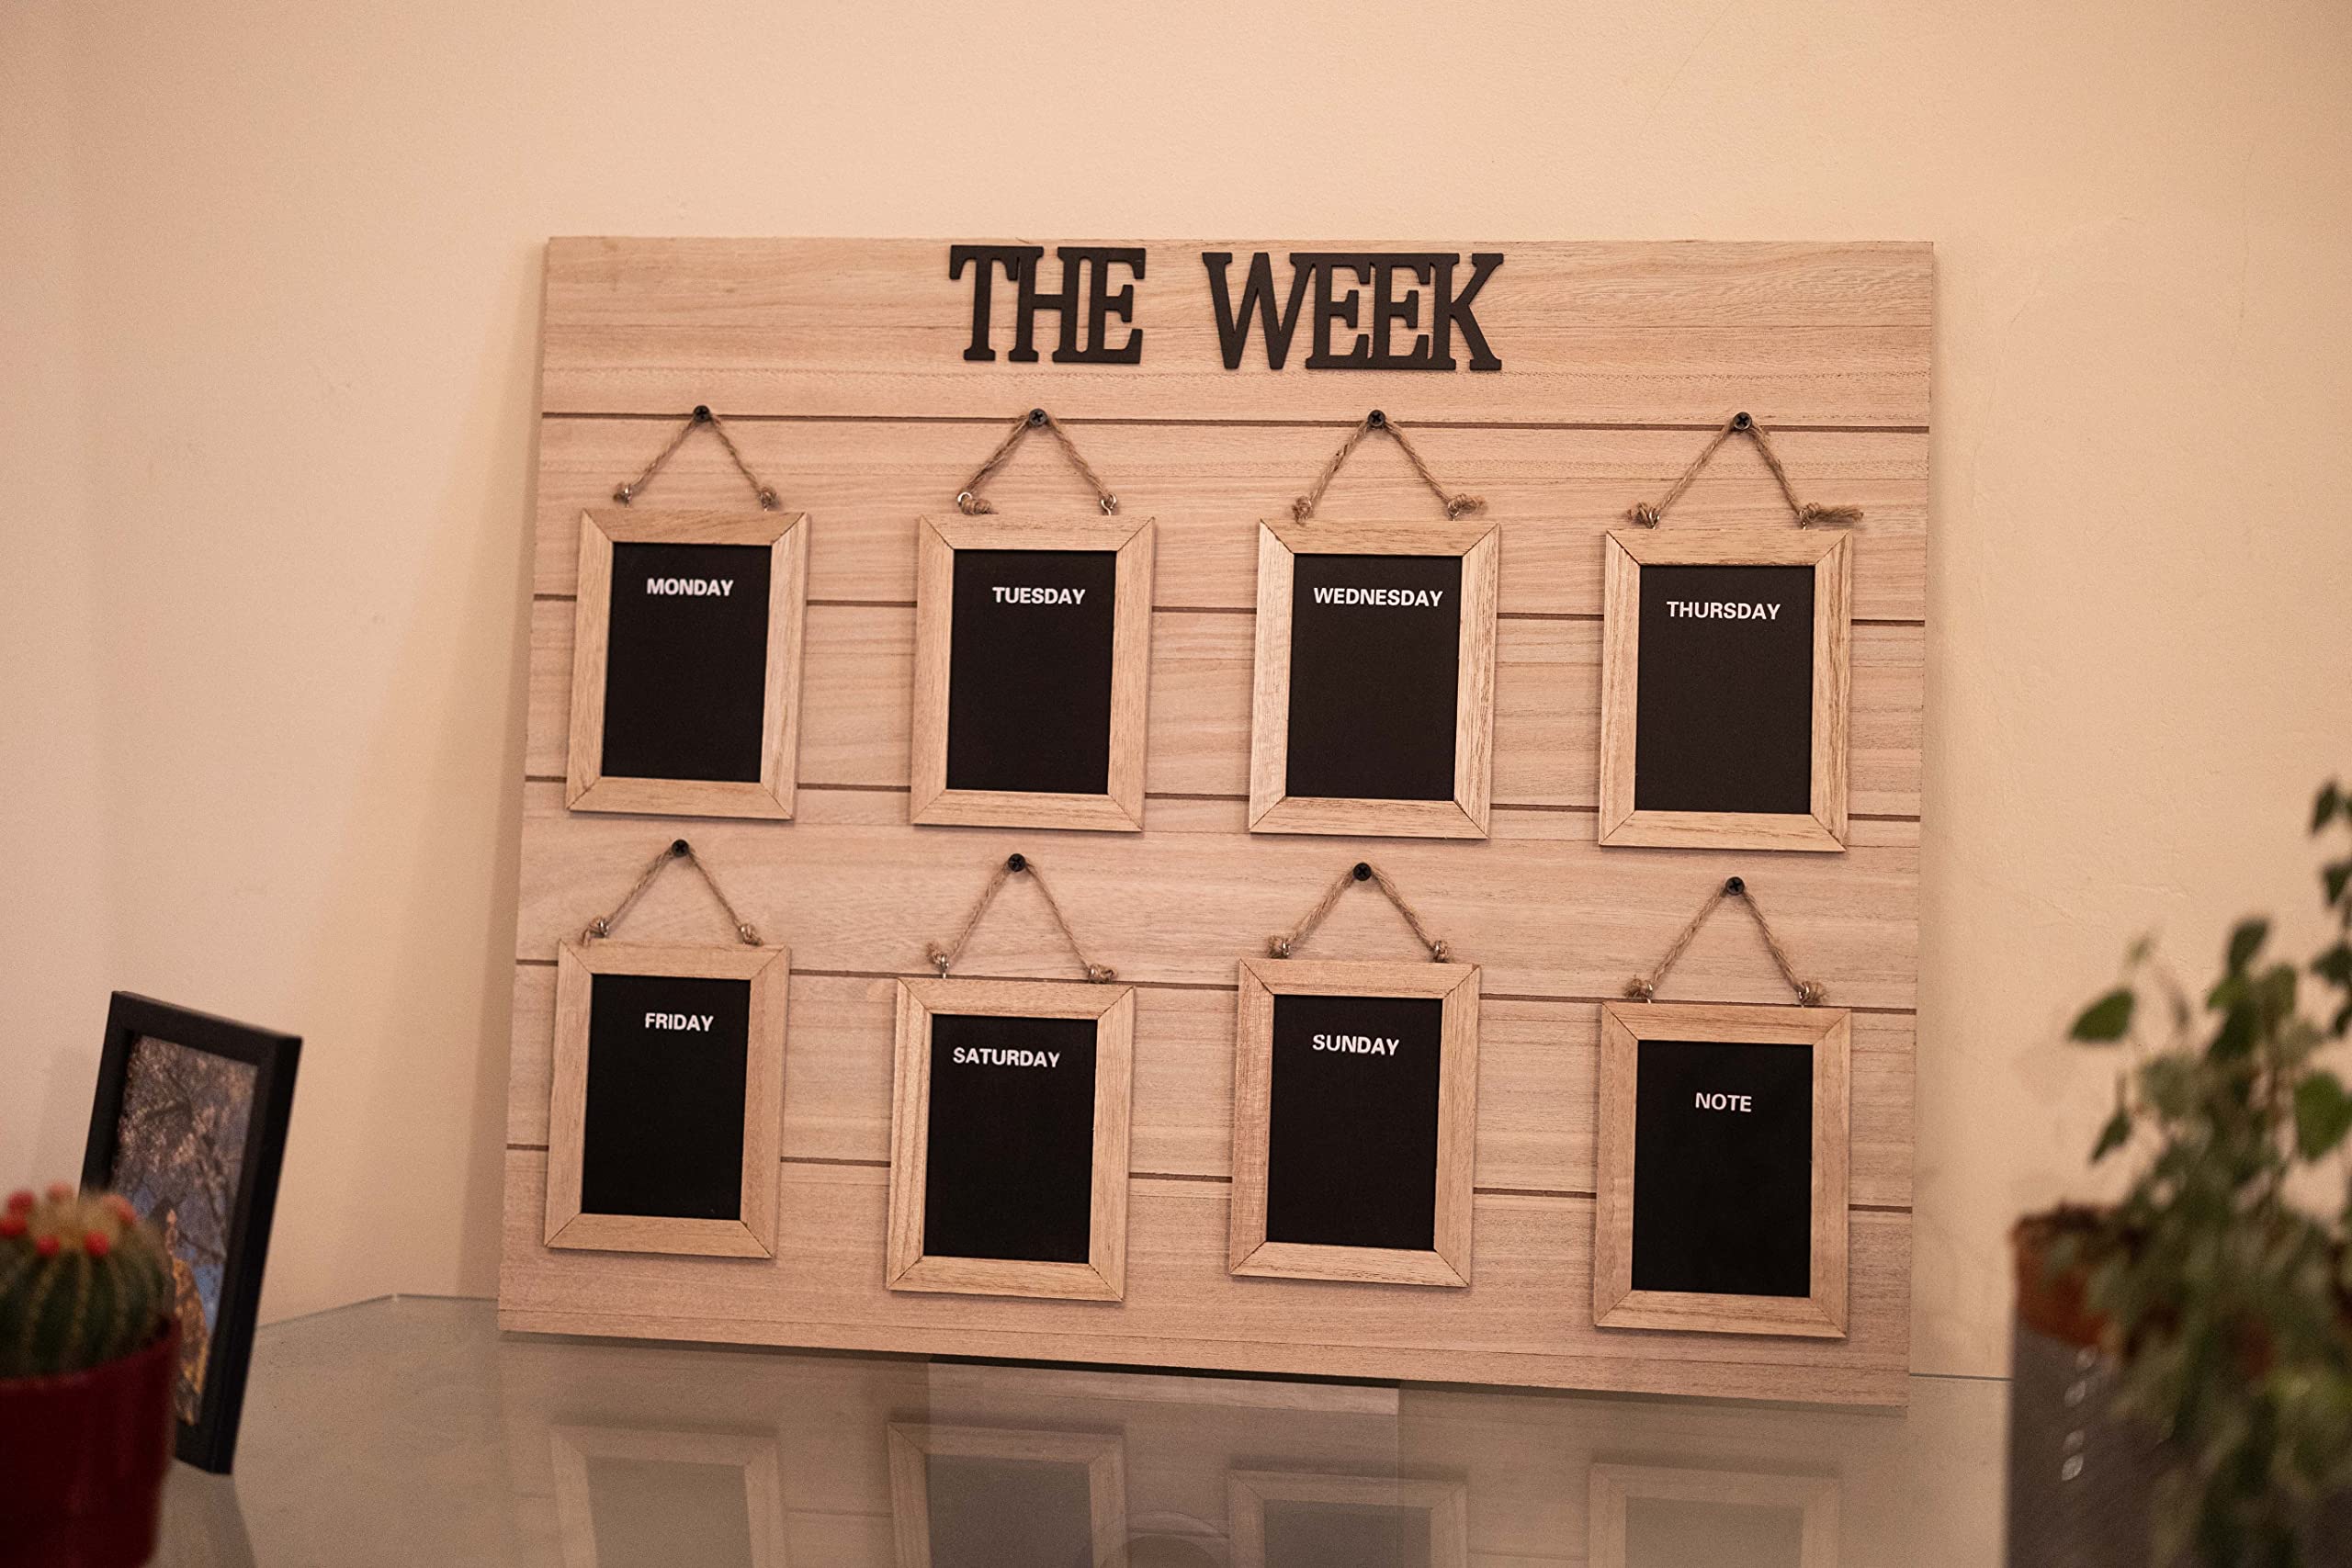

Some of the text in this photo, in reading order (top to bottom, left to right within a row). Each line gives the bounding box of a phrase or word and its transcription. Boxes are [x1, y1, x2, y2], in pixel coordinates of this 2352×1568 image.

[949, 244, 1505, 372] THE WEEK
[646, 578, 734, 597] MONDAY
[991, 586, 1086, 605] TUESDAY
[1313, 587, 1443, 607] WEDNESDAY
[1666, 601, 1781, 620] THURSDAY
[645, 1012, 714, 1032] FRIDAY
[1312, 1033, 1400, 1056] SUNDAY
[953, 1046, 1060, 1068] SATURDAY
[1695, 1092, 1752, 1112] NOTE
